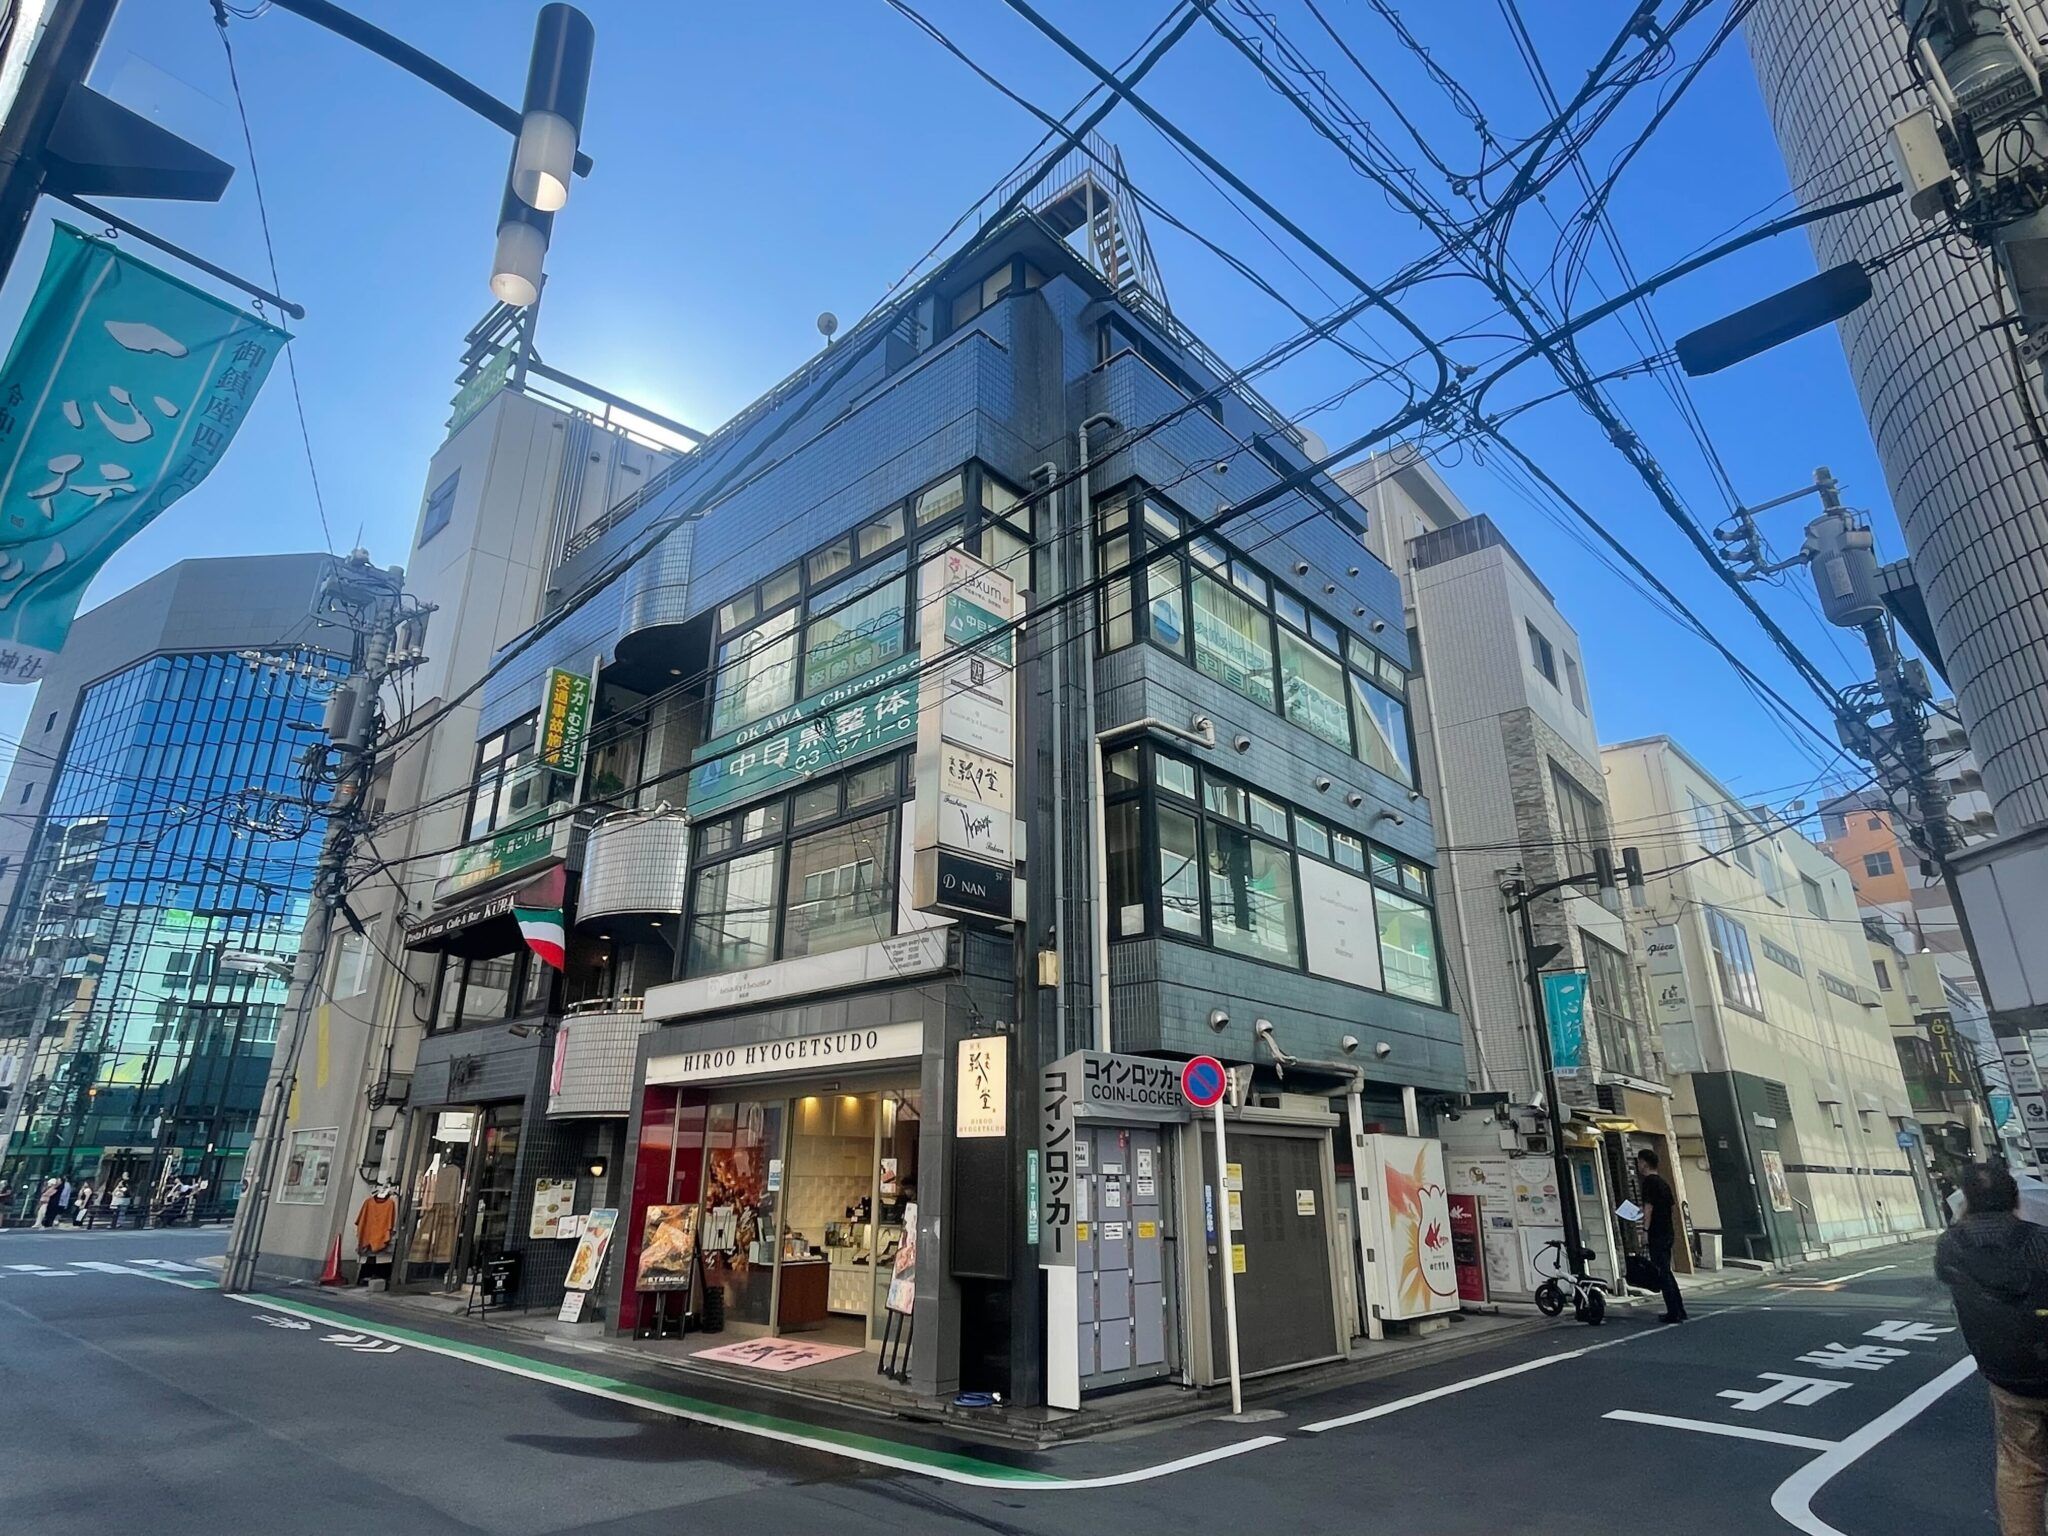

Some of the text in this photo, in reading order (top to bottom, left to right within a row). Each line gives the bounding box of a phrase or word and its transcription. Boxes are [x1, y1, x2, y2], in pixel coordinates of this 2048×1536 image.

[729, 687, 921, 778] 中目黒整体
[735, 707, 802, 746] OKAWA
[795, 712, 921, 771] 03-3711-6
[961, 880, 987, 897] NAN
[683, 1030, 879, 1072] HIROO HYOGETSUDO
[1091, 1083, 1184, 1107] COIN-LOCKER
[1044, 1071, 1071, 1254] コインロッカー
